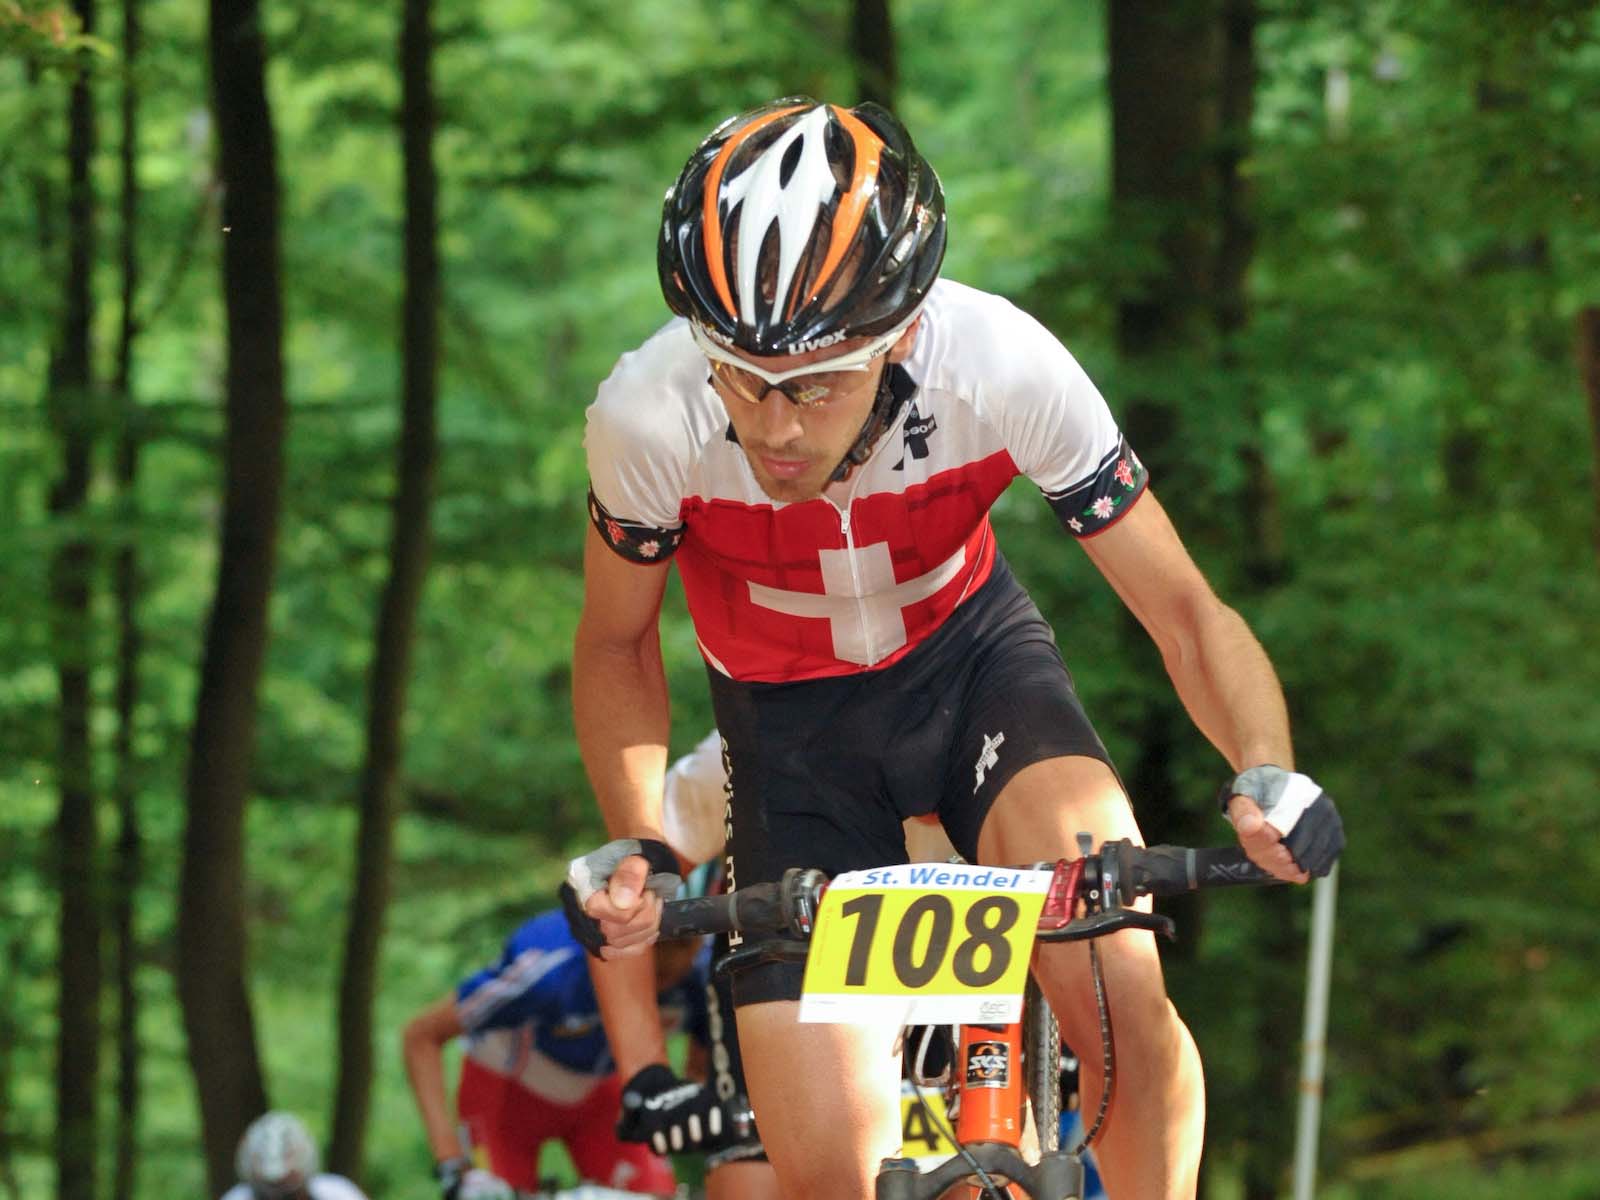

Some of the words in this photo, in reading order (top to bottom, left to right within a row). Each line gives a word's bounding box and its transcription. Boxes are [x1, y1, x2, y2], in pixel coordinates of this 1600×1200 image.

[788, 327, 848, 355] uvex
[862, 870, 898, 886] St.
[908, 867, 1022, 888] Wendel
[841, 893, 1020, 989] 108
